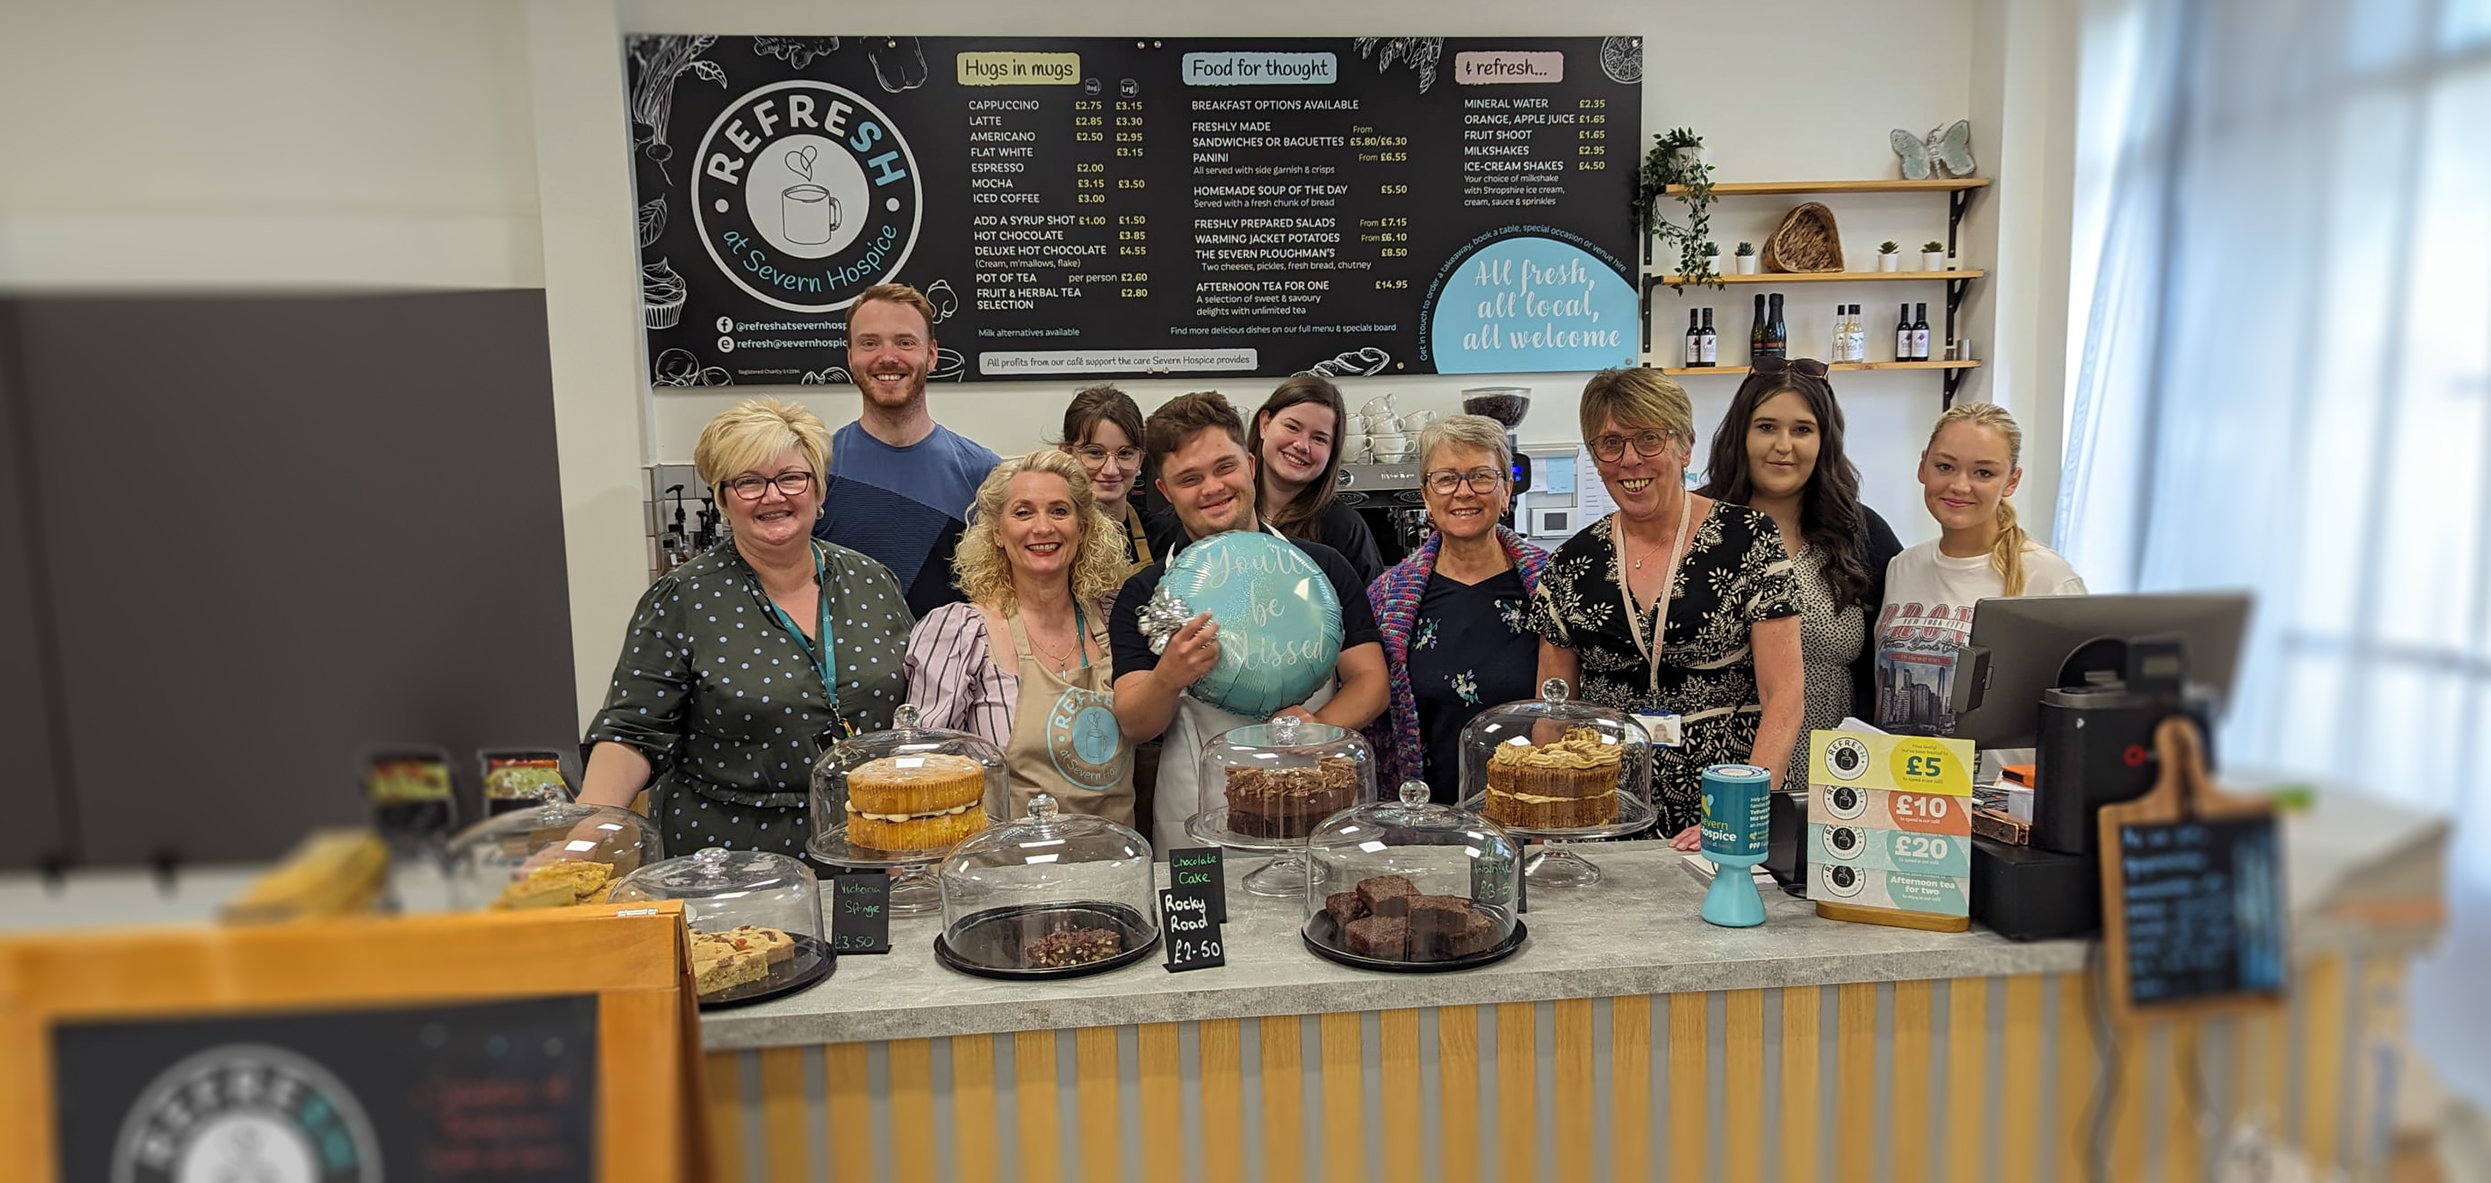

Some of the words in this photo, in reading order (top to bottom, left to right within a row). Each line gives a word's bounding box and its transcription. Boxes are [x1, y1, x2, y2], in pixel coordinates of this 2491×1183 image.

[965, 58, 1008, 80] Hugs
[1013, 58, 1027, 76] in
[1032, 65, 1073, 80] mugs
[1193, 58, 1233, 77] Food
[1237, 58, 1261, 77] for
[1266, 58, 1328, 80] thought
[1477, 58, 1547, 76] refresh...
[969, 100, 1040, 110] CAPPUCCINO
[1075, 101, 1102, 110] £2.75
[1115, 101, 1142, 111] £3.15
[1191, 101, 1252, 110] BREAKFAST
[1254, 100, 1301, 110] OPTIONS
[1304, 100, 1359, 110] AVAILABLE
[1464, 99, 1511, 109] MINERAL
[1513, 99, 1549, 108] WATER
[1579, 100, 1605, 108] £2.35
[969, 116, 1002, 126] LATTE
[1075, 117, 1102, 126] £2.85
[1116, 117, 1143, 126] £3.30
[1464, 114, 1512, 125] ORANGE,
[1514, 114, 1545, 124] APPLE
[1547, 114, 1575, 124] JUICE
[1579, 115, 1605, 123] £1.65
[1192, 122, 1237, 132] FRESHLY
[1240, 122, 1271, 131] MADE
[1353, 125, 1372, 134] From
[706, 94, 907, 187] REFRESH
[970, 132, 1036, 142] AMERICANO
[1076, 132, 1103, 141] £2.50
[1116, 133, 1143, 142] £2.95
[1464, 130, 1494, 140] FRUIT
[1496, 130, 1532, 139] SHOOT
[1579, 130, 1605, 139] £1.65
[1192, 137, 1263, 147] SANDWICHES
[1265, 137, 1281, 147] OR
[1283, 137, 1344, 147] BAGUETTES
[1350, 137, 1407, 146] £5.80/£6.30
[970, 148, 995, 157] FLAT
[999, 148, 1033, 157] WHITE
[1116, 148, 1143, 157] £3.15
[1464, 146, 1529, 155] MILKSHAKES
[1579, 146, 1605, 154] £2.95
[1193, 153, 1229, 163] PANINI
[1359, 153, 1378, 162] From
[1380, 153, 1407, 162] £6.55
[971, 163, 1024, 173] ESPRESSO
[1077, 164, 1104, 173] £2.00
[1464, 162, 1521, 171] ICE-CREAM
[1523, 161, 1564, 171] SHAKES
[1579, 161, 1605, 170] £4.50
[972, 179, 1013, 188] MOCHA
[1077, 179, 1105, 188] £3.15
[1118, 180, 1145, 189] £3.50
[1194, 186, 1256, 196] HOMEMADE
[1257, 185, 1286, 195] SOUP
[1288, 185, 1302, 195] OF
[1305, 185, 1325, 195] THE
[1327, 185, 1348, 195] DAY
[1381, 185, 1407, 194] £5.50
[973, 194, 998, 203] ICED
[1000, 193, 1040, 203] COFFEE
[1078, 194, 1105, 203] £3.00
[974, 216, 997, 226] ADD
[1000, 216, 1008, 225] A
[1010, 216, 1045, 225] SYRUP
[1047, 215, 1076, 225] SHOT
[1078, 216, 1106, 226] £1.00
[1119, 216, 1146, 225] £1.50
[1195, 219, 1238, 229] FRESHLY
[1241, 219, 1293, 228] PREPARED
[1296, 218, 1336, 228] SALADS
[1360, 219, 1378, 227] From
[1381, 218, 1407, 227] £7.15
[974, 231, 997, 240] HOT
[999, 231, 1064, 240] CHOCOLATE
[1119, 231, 1146, 240] £3.85
[1195, 234, 1247, 244] WARMING
[1249, 234, 1286, 244] JACKET
[1288, 233, 1340, 243] POTATOES
[1361, 233, 1380, 242] From
[1381, 233, 1407, 242] £6.10
[974, 246, 1016, 256] DELUXE
[1018, 246, 1041, 256] HOT
[1043, 246, 1107, 255] CHOCOLATE
[1120, 246, 1146, 255] £4.55
[1195, 250, 1215, 260] THE
[1218, 250, 1257, 260] SEVERN
[1260, 248, 1336, 259] PLOUGHMAN'S
[1381, 248, 1408, 257] £8.50
[723, 230, 749, 255] at
[743, 249, 822, 293] Severn
[826, 224, 897, 291] Hospice
[975, 260, 1008, 269] (Cream,
[1010, 259, 1056, 269] m'mallows,
[1058, 258, 1081, 268] flake)
[976, 274, 997, 283] POT
[1000, 274, 1014, 282] OF
[1016, 273, 1037, 283] TEA
[1069, 274, 1083, 283] per
[1086, 274, 1117, 283] person
[1121, 273, 1148, 281] £2.60
[1474, 258, 1512, 286] All
[1520, 258, 1595, 297] fresh,
[1196, 282, 1261, 292] AFTERNOON
[1262, 281, 1282, 291] TEA
[1284, 281, 1306, 291] FOR
[1307, 281, 1329, 291] ONE
[1375, 280, 1408, 290] £14.95
[977, 289, 1007, 298] FRUIT
[1009, 289, 1016, 298] &
[1018, 288, 1059, 298] HERBAL
[1061, 288, 1082, 297] TEA
[1121, 288, 1148, 297] £2.80
[977, 300, 1034, 310] SELECTION
[1477, 292, 1516, 319] all
[1526, 290, 1600, 323] local,
[1197, 307, 1229, 317] delights
[1231, 307, 1250, 315] with
[1252, 306, 1291, 315] unlimited
[1292, 306, 1306, 314] tea
[978, 329, 995, 337] Milk
[996, 328, 1044, 337] alternatives
[1045, 328, 1080, 337] available
[1463, 323, 1502, 351] all
[1510, 322, 1620, 349] welcome
[1250, 579, 1285, 627] be
[1828, 739, 1866, 759] REFRESH
[1066, 760, 1100, 780] Severn
[1906, 755, 1941, 777] £5
[1896, 794, 1947, 818] £10
[1895, 836, 1948, 859] £20
[1172, 853, 1217, 868] Chocolate
[1179, 871, 1211, 885] Cake
[1890, 876, 1938, 887] Afternoon
[1940, 881, 1955, 889] tea
[840, 879, 880, 894] Victoria
[1921, 887, 1939, 895] two
[1165, 894, 1206, 914] Rocky
[1170, 913, 1208, 933] Road
